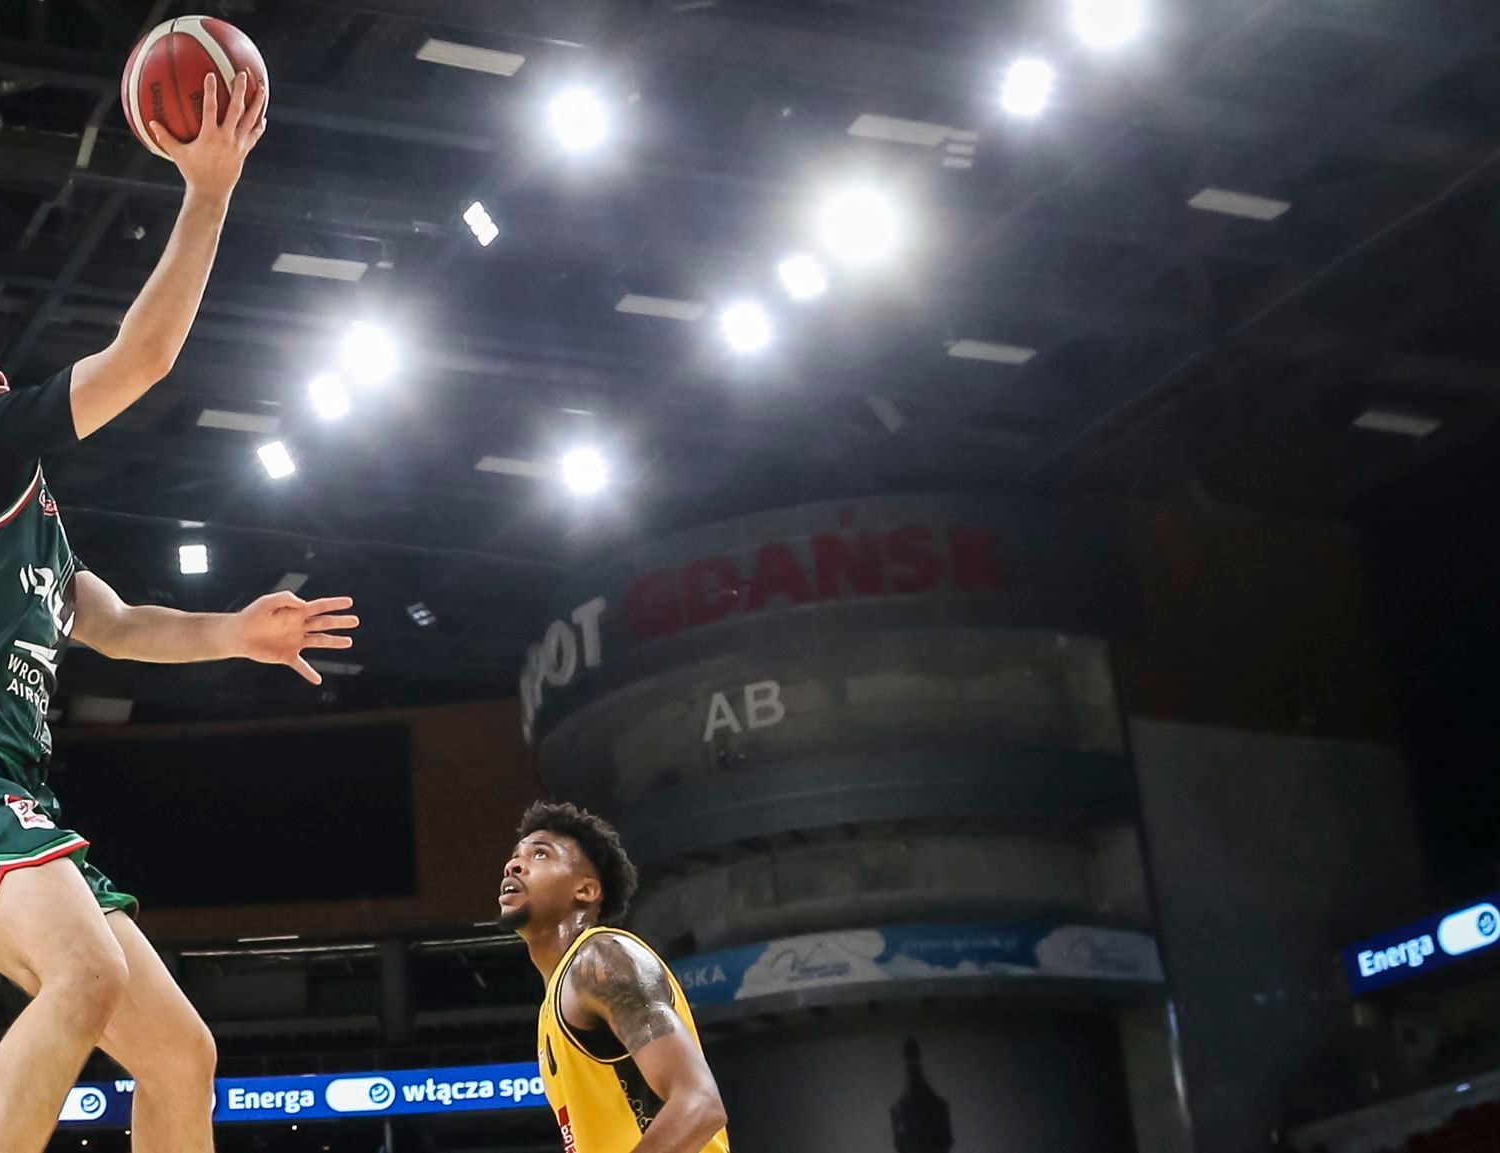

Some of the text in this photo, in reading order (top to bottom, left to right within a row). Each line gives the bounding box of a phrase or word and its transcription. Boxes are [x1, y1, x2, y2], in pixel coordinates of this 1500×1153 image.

[8, 653, 41, 685] WRO
[703, 680, 786, 742] AB
[1358, 934, 1435, 977] Energa
[683, 964, 726, 989] SKA
[227, 1075, 545, 1113] Energa włącza spo
